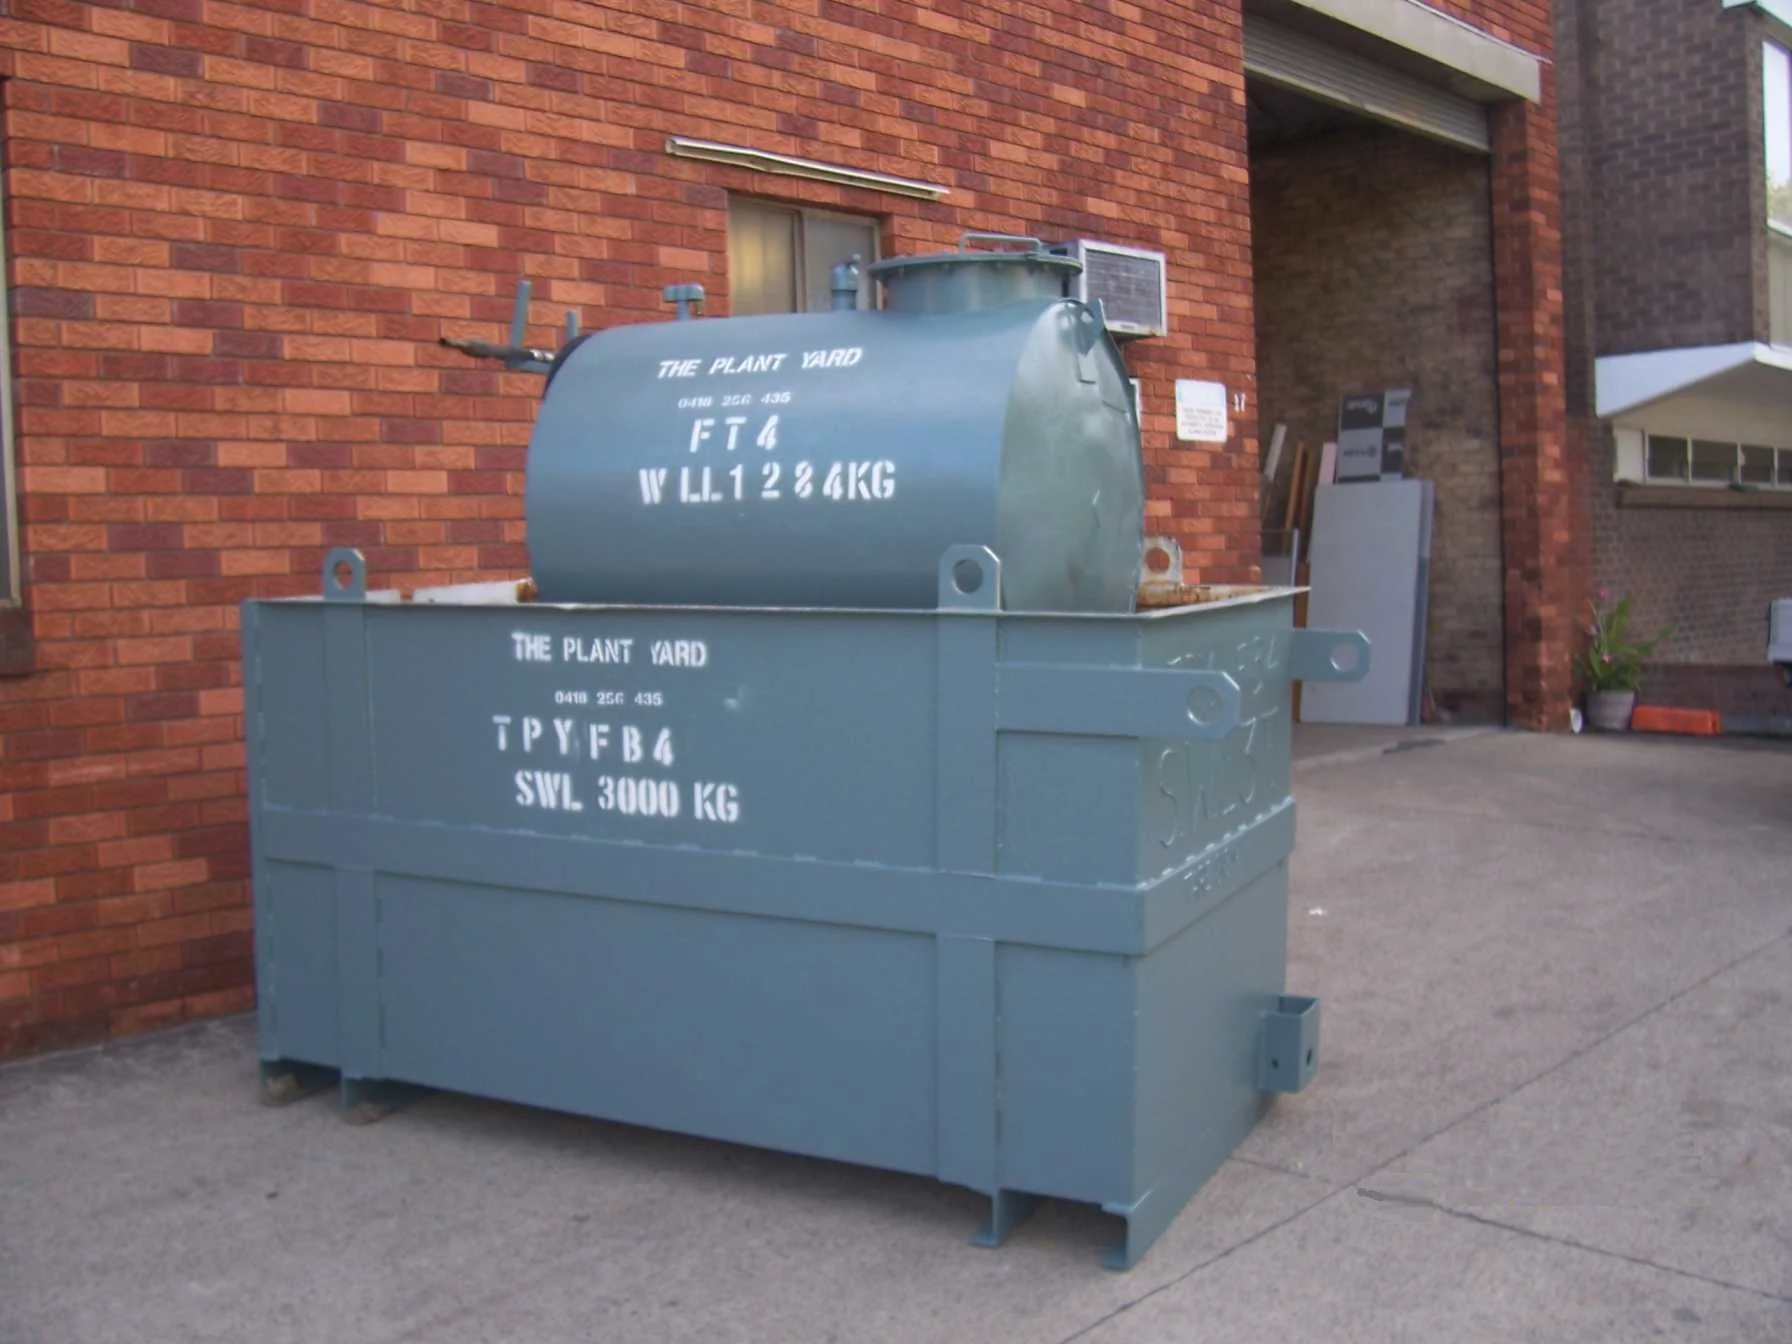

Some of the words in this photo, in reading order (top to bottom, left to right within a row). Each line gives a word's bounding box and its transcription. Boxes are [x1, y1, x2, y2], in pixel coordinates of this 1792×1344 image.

[658, 360, 701, 378] THE
[709, 354, 787, 374] PLANT
[802, 347, 863, 368] YARD
[512, 632, 551, 661] THE
[564, 638, 632, 663] PLANT
[651, 640, 707, 666] YARD
[635, 692, 663, 706] 435
[515, 771, 582, 810] SWL
[599, 776, 679, 816] 3000
[695, 783, 738, 822] KG
